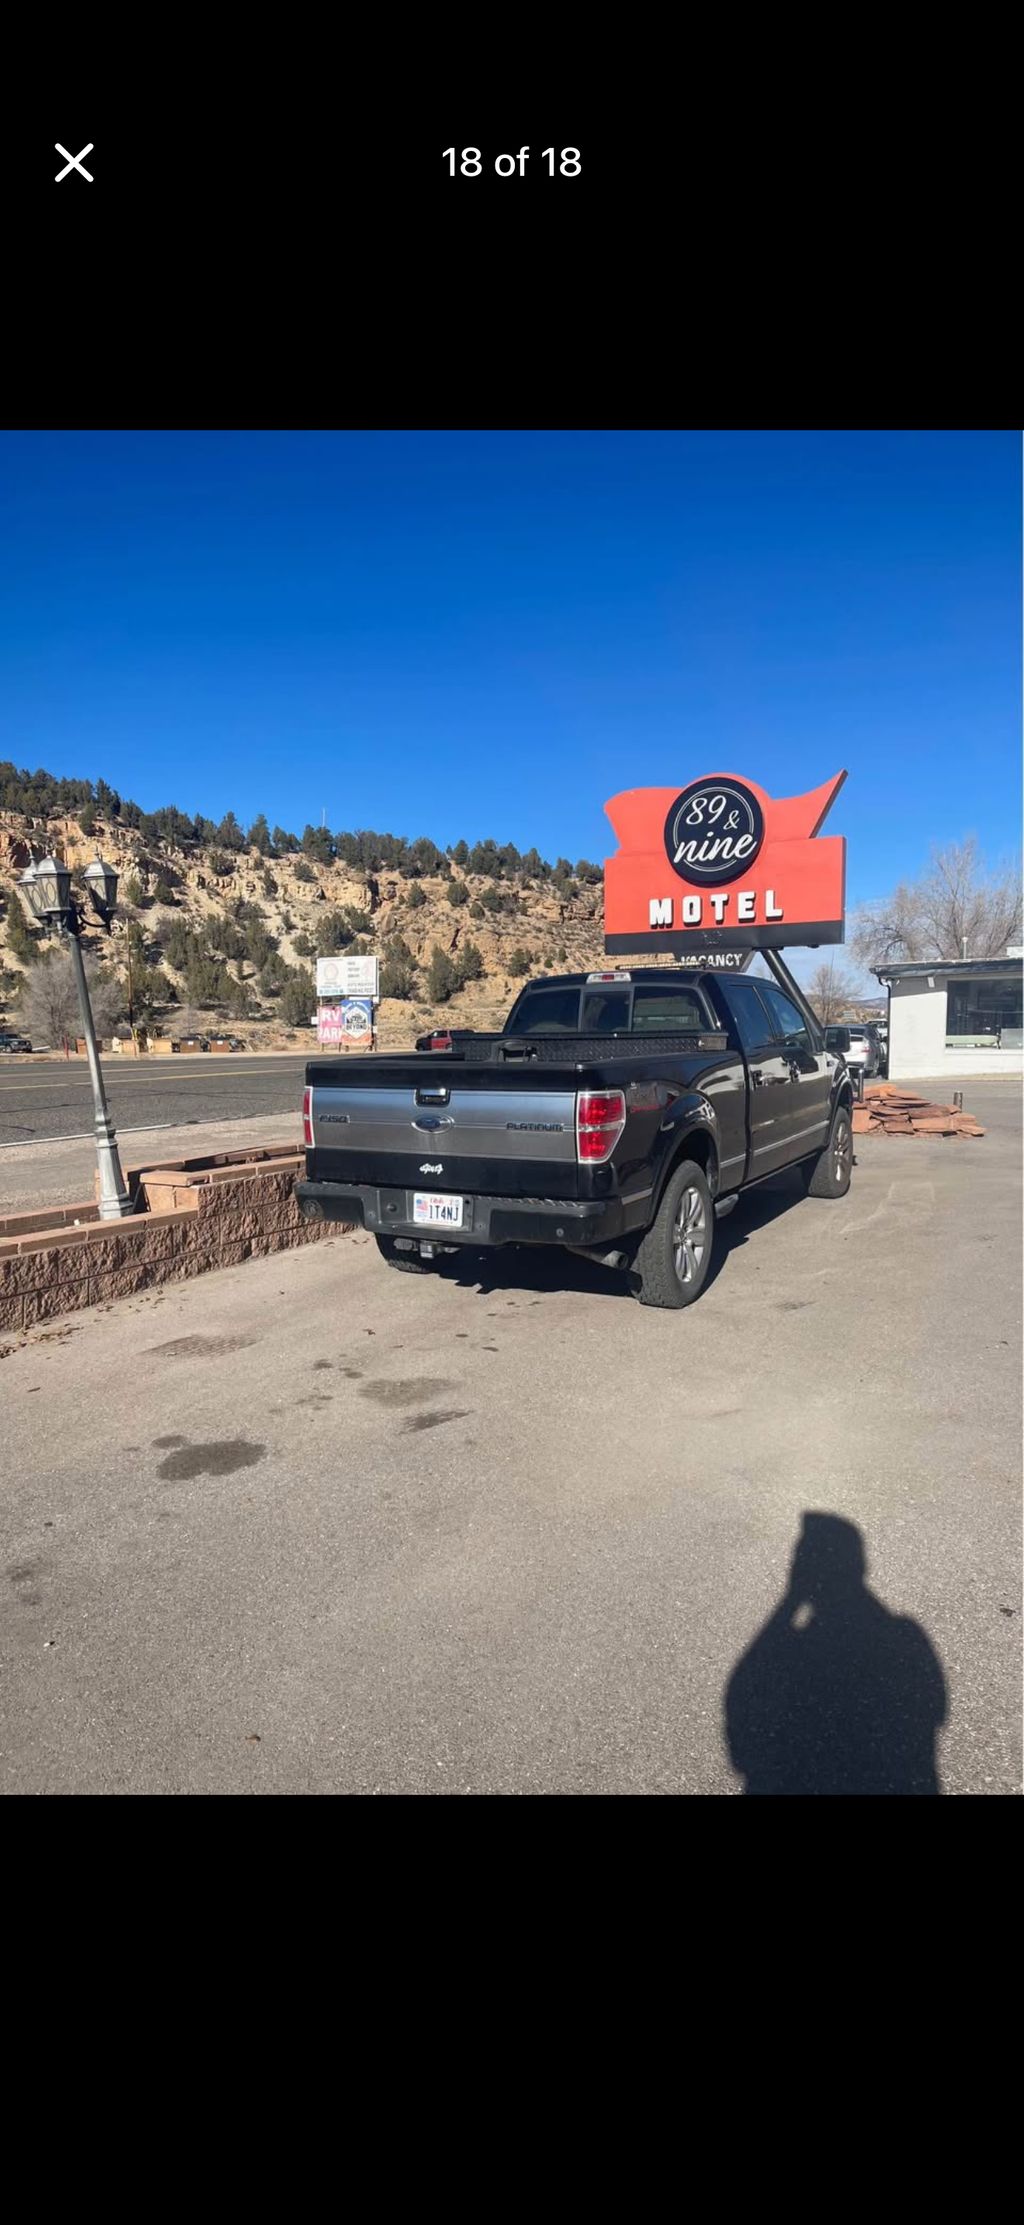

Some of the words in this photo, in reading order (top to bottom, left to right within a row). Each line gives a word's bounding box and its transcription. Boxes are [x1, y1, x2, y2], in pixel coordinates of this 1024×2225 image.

[685, 795, 727, 825] 89
[723, 810, 740, 830] &
[673, 831, 758, 864] nine
[649, 890, 783, 929] MOTEL
[680, 953, 742, 968] VACANCY
[321, 1010, 341, 1022] RV
[506, 1122, 563, 1132] PLATINUM
